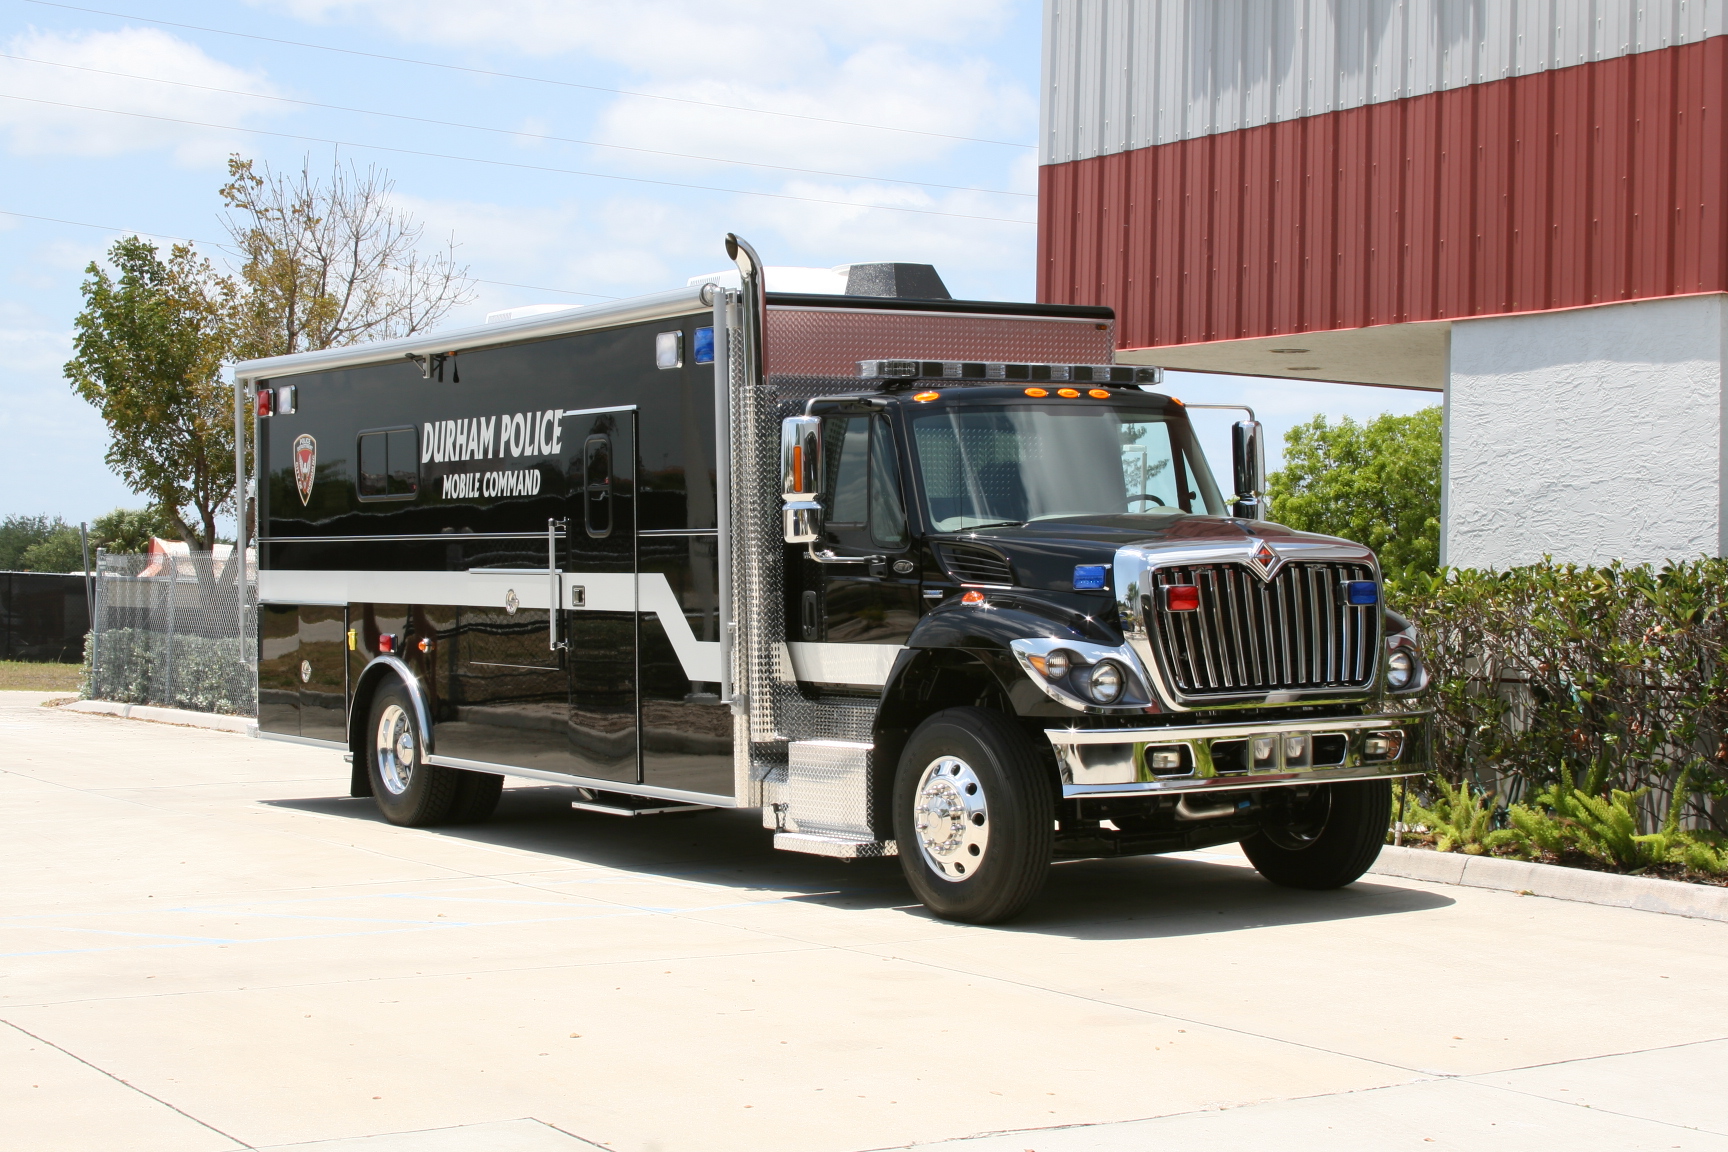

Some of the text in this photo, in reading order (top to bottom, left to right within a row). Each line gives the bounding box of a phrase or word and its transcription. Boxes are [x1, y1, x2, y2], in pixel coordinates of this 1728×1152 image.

[421, 408, 564, 464] DURHAM POLICE
[442, 469, 541, 499] MOBILE COMMAND
